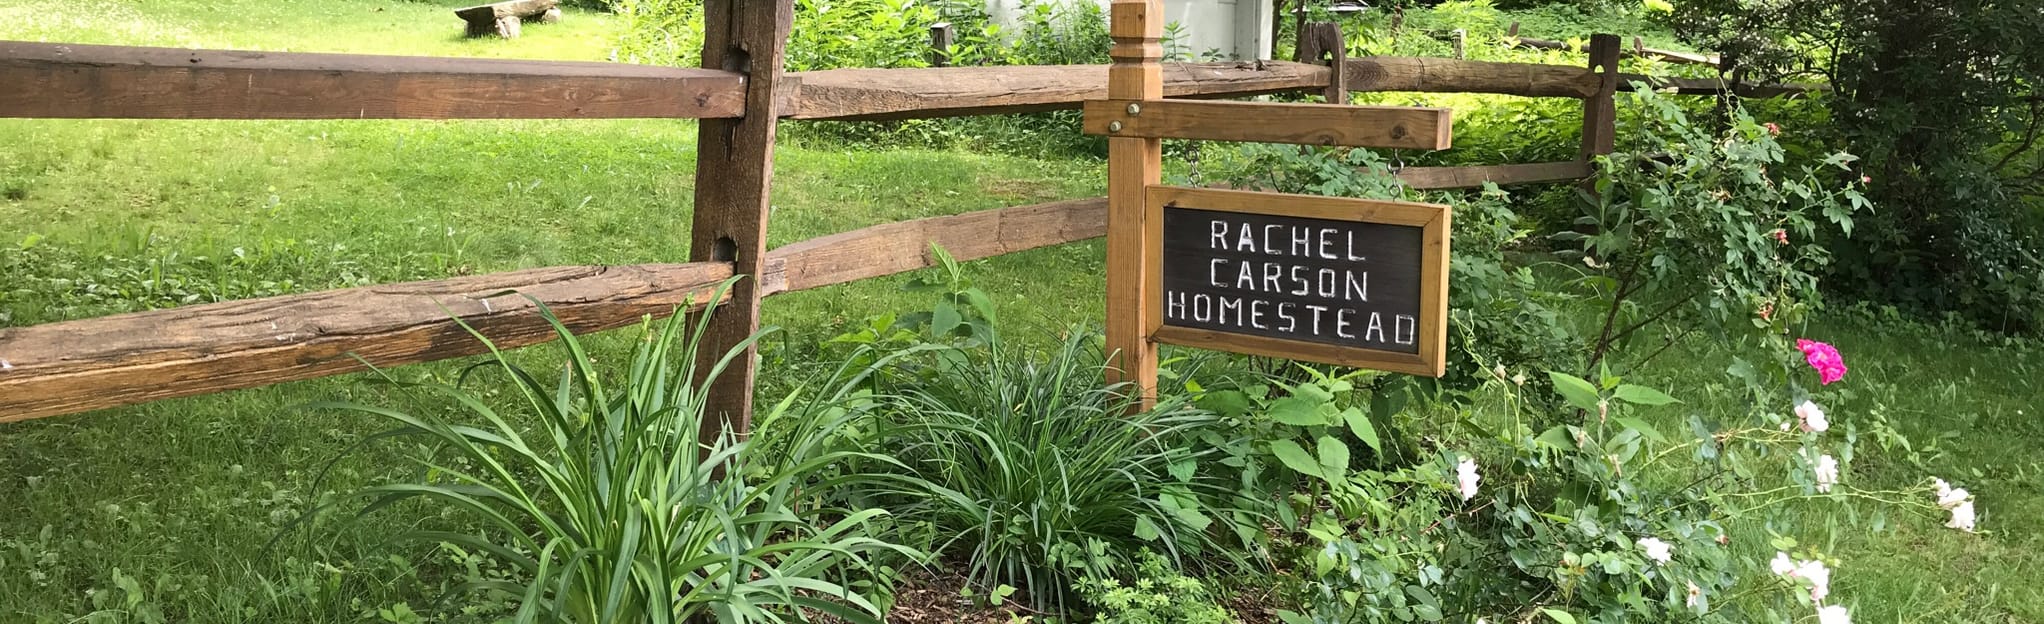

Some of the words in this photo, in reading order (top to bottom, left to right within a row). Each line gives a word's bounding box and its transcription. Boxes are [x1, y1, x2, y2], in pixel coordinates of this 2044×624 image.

[1210, 220, 1366, 262] RACHEL
[1210, 258, 1368, 302] CARSON
[1167, 290, 1415, 346] HOMESTEAD
